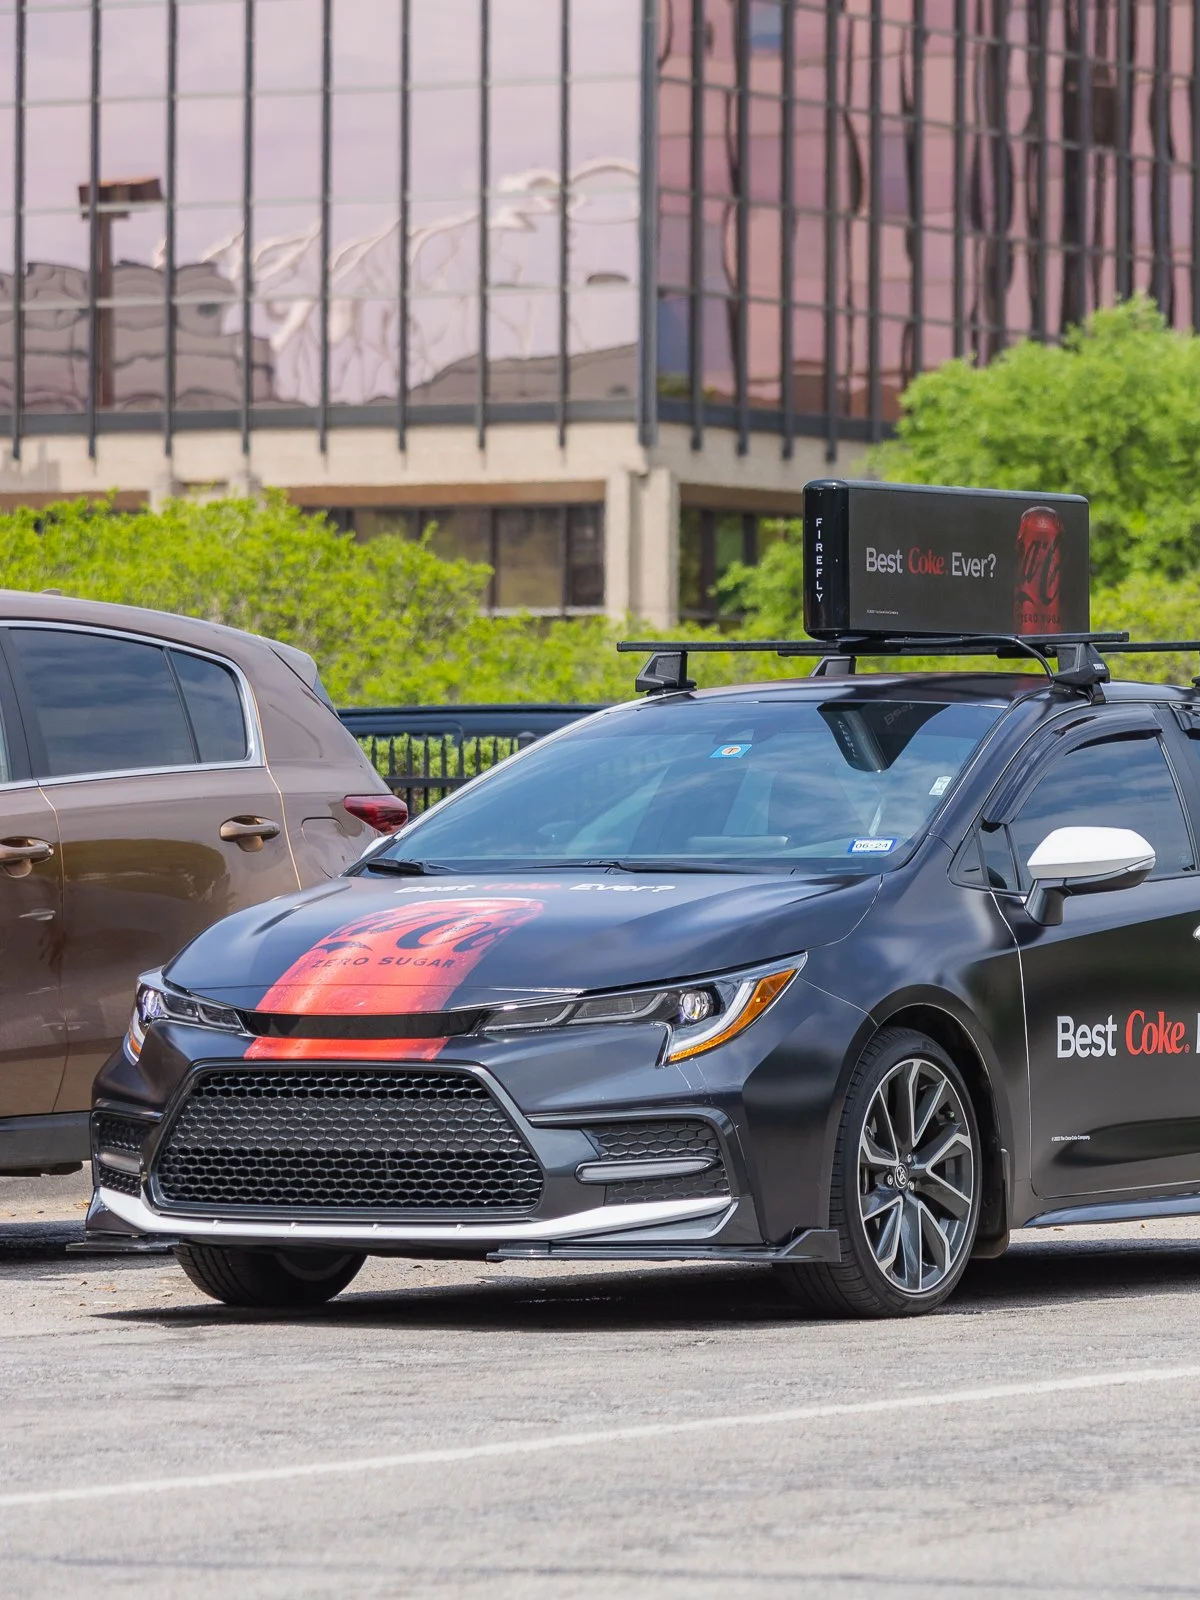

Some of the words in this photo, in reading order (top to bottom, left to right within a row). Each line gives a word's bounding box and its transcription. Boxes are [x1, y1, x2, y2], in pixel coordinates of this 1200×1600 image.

[815, 517, 824, 603] FIREFLY
[866, 547, 903, 574] Best
[951, 551, 997, 578] Ever?
[311, 957, 370, 968] ZERO
[377, 956, 456, 969] SUGAR
[1056, 1014, 1118, 1059] Best
